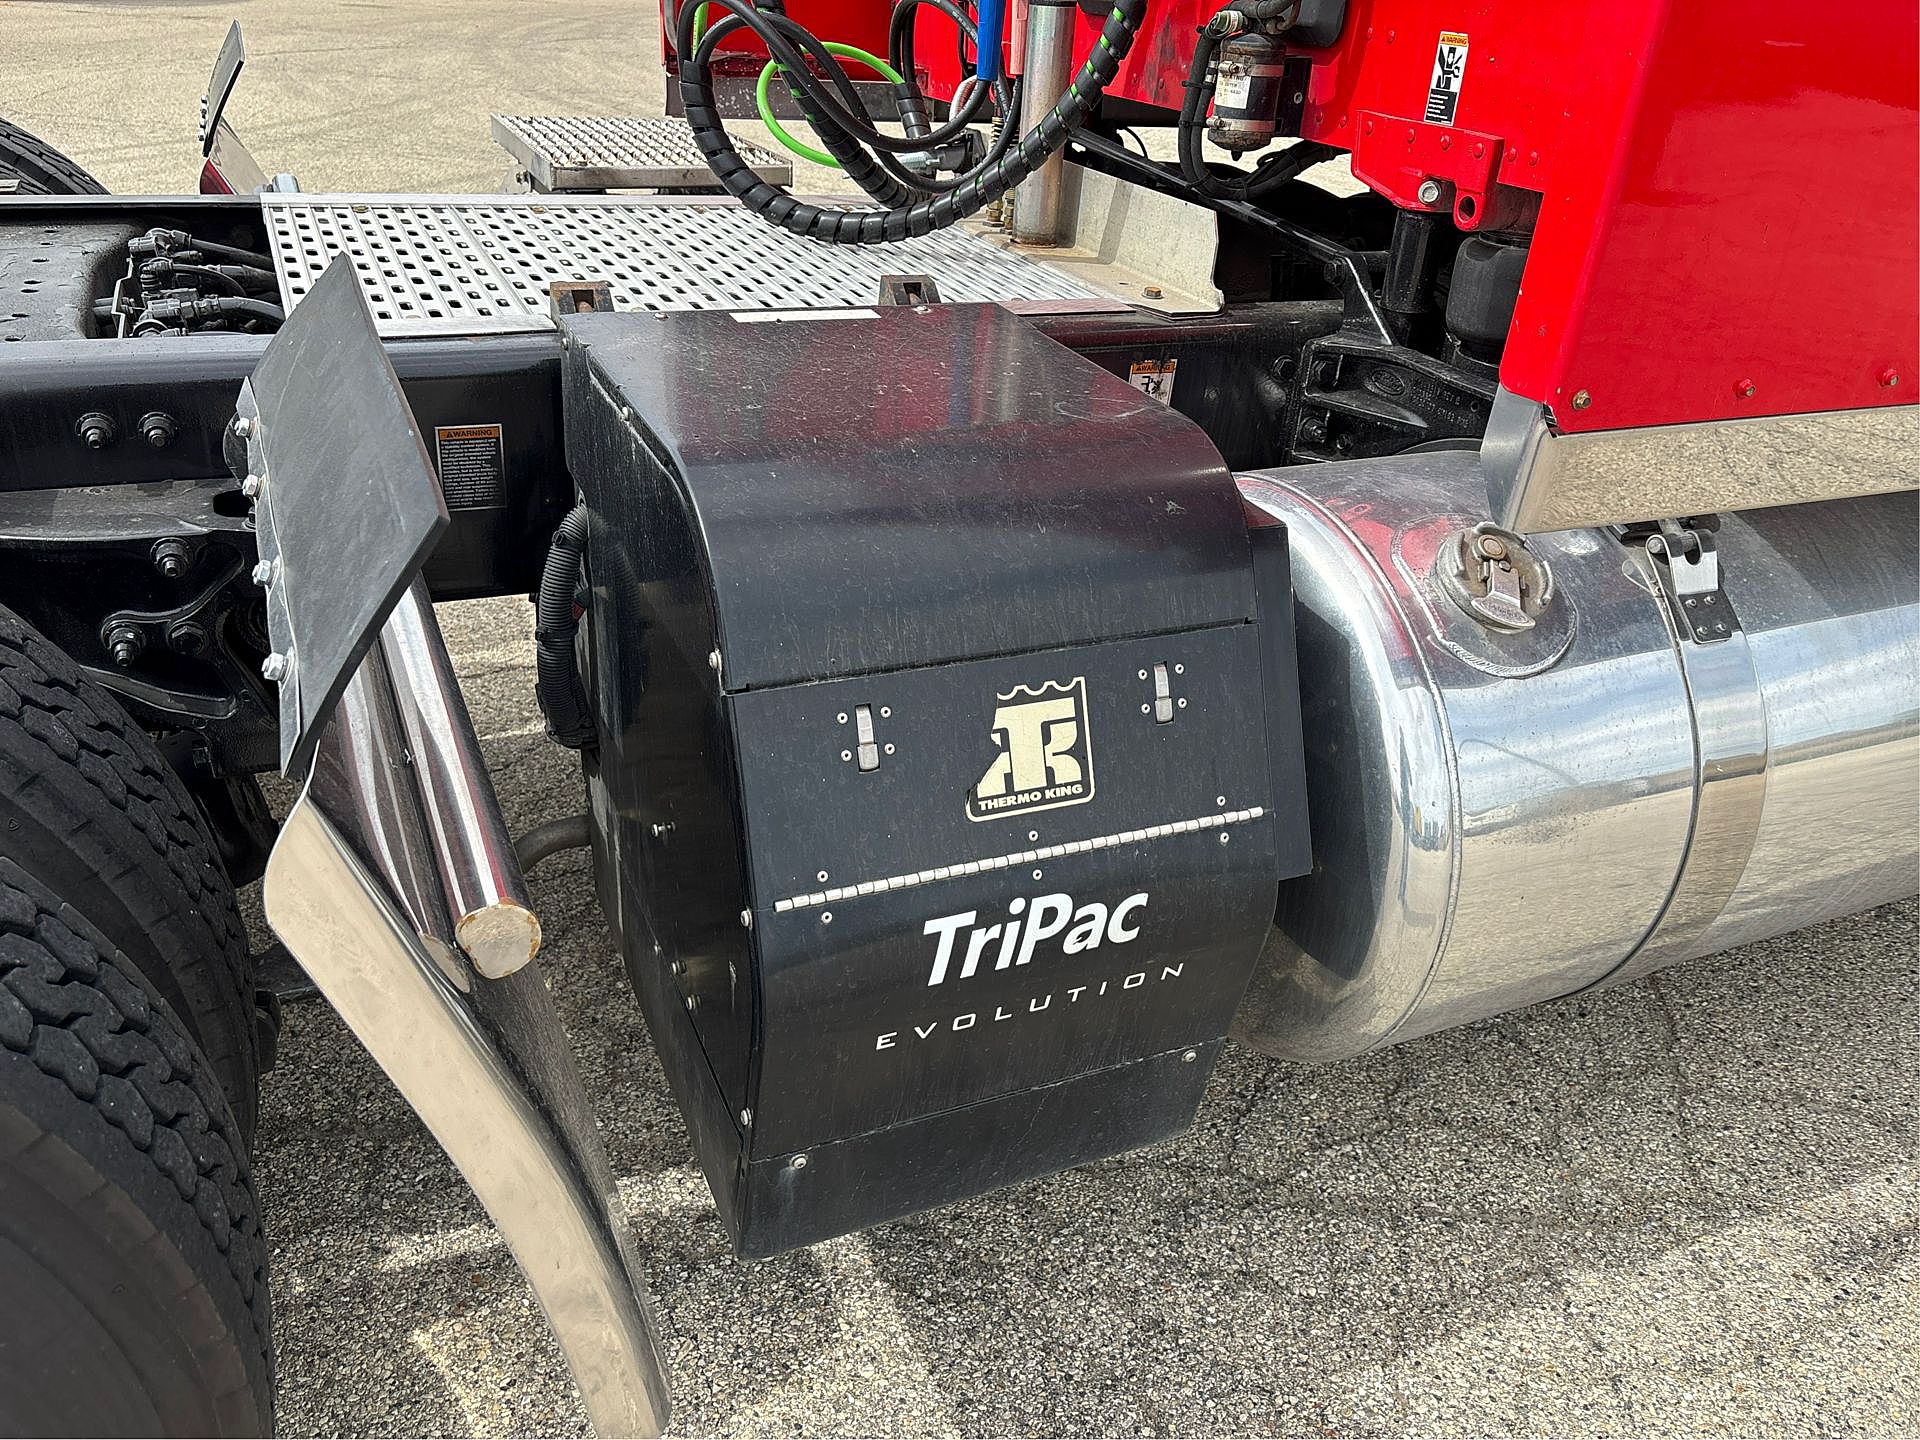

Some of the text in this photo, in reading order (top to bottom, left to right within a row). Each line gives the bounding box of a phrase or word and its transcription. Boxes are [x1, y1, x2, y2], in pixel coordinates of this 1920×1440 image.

[452, 429, 492, 437] WARNING
[978, 784, 1083, 811] THERMO KING
[923, 893, 1149, 987] TriPac
[875, 962, 1184, 1051] EVOLUTION
